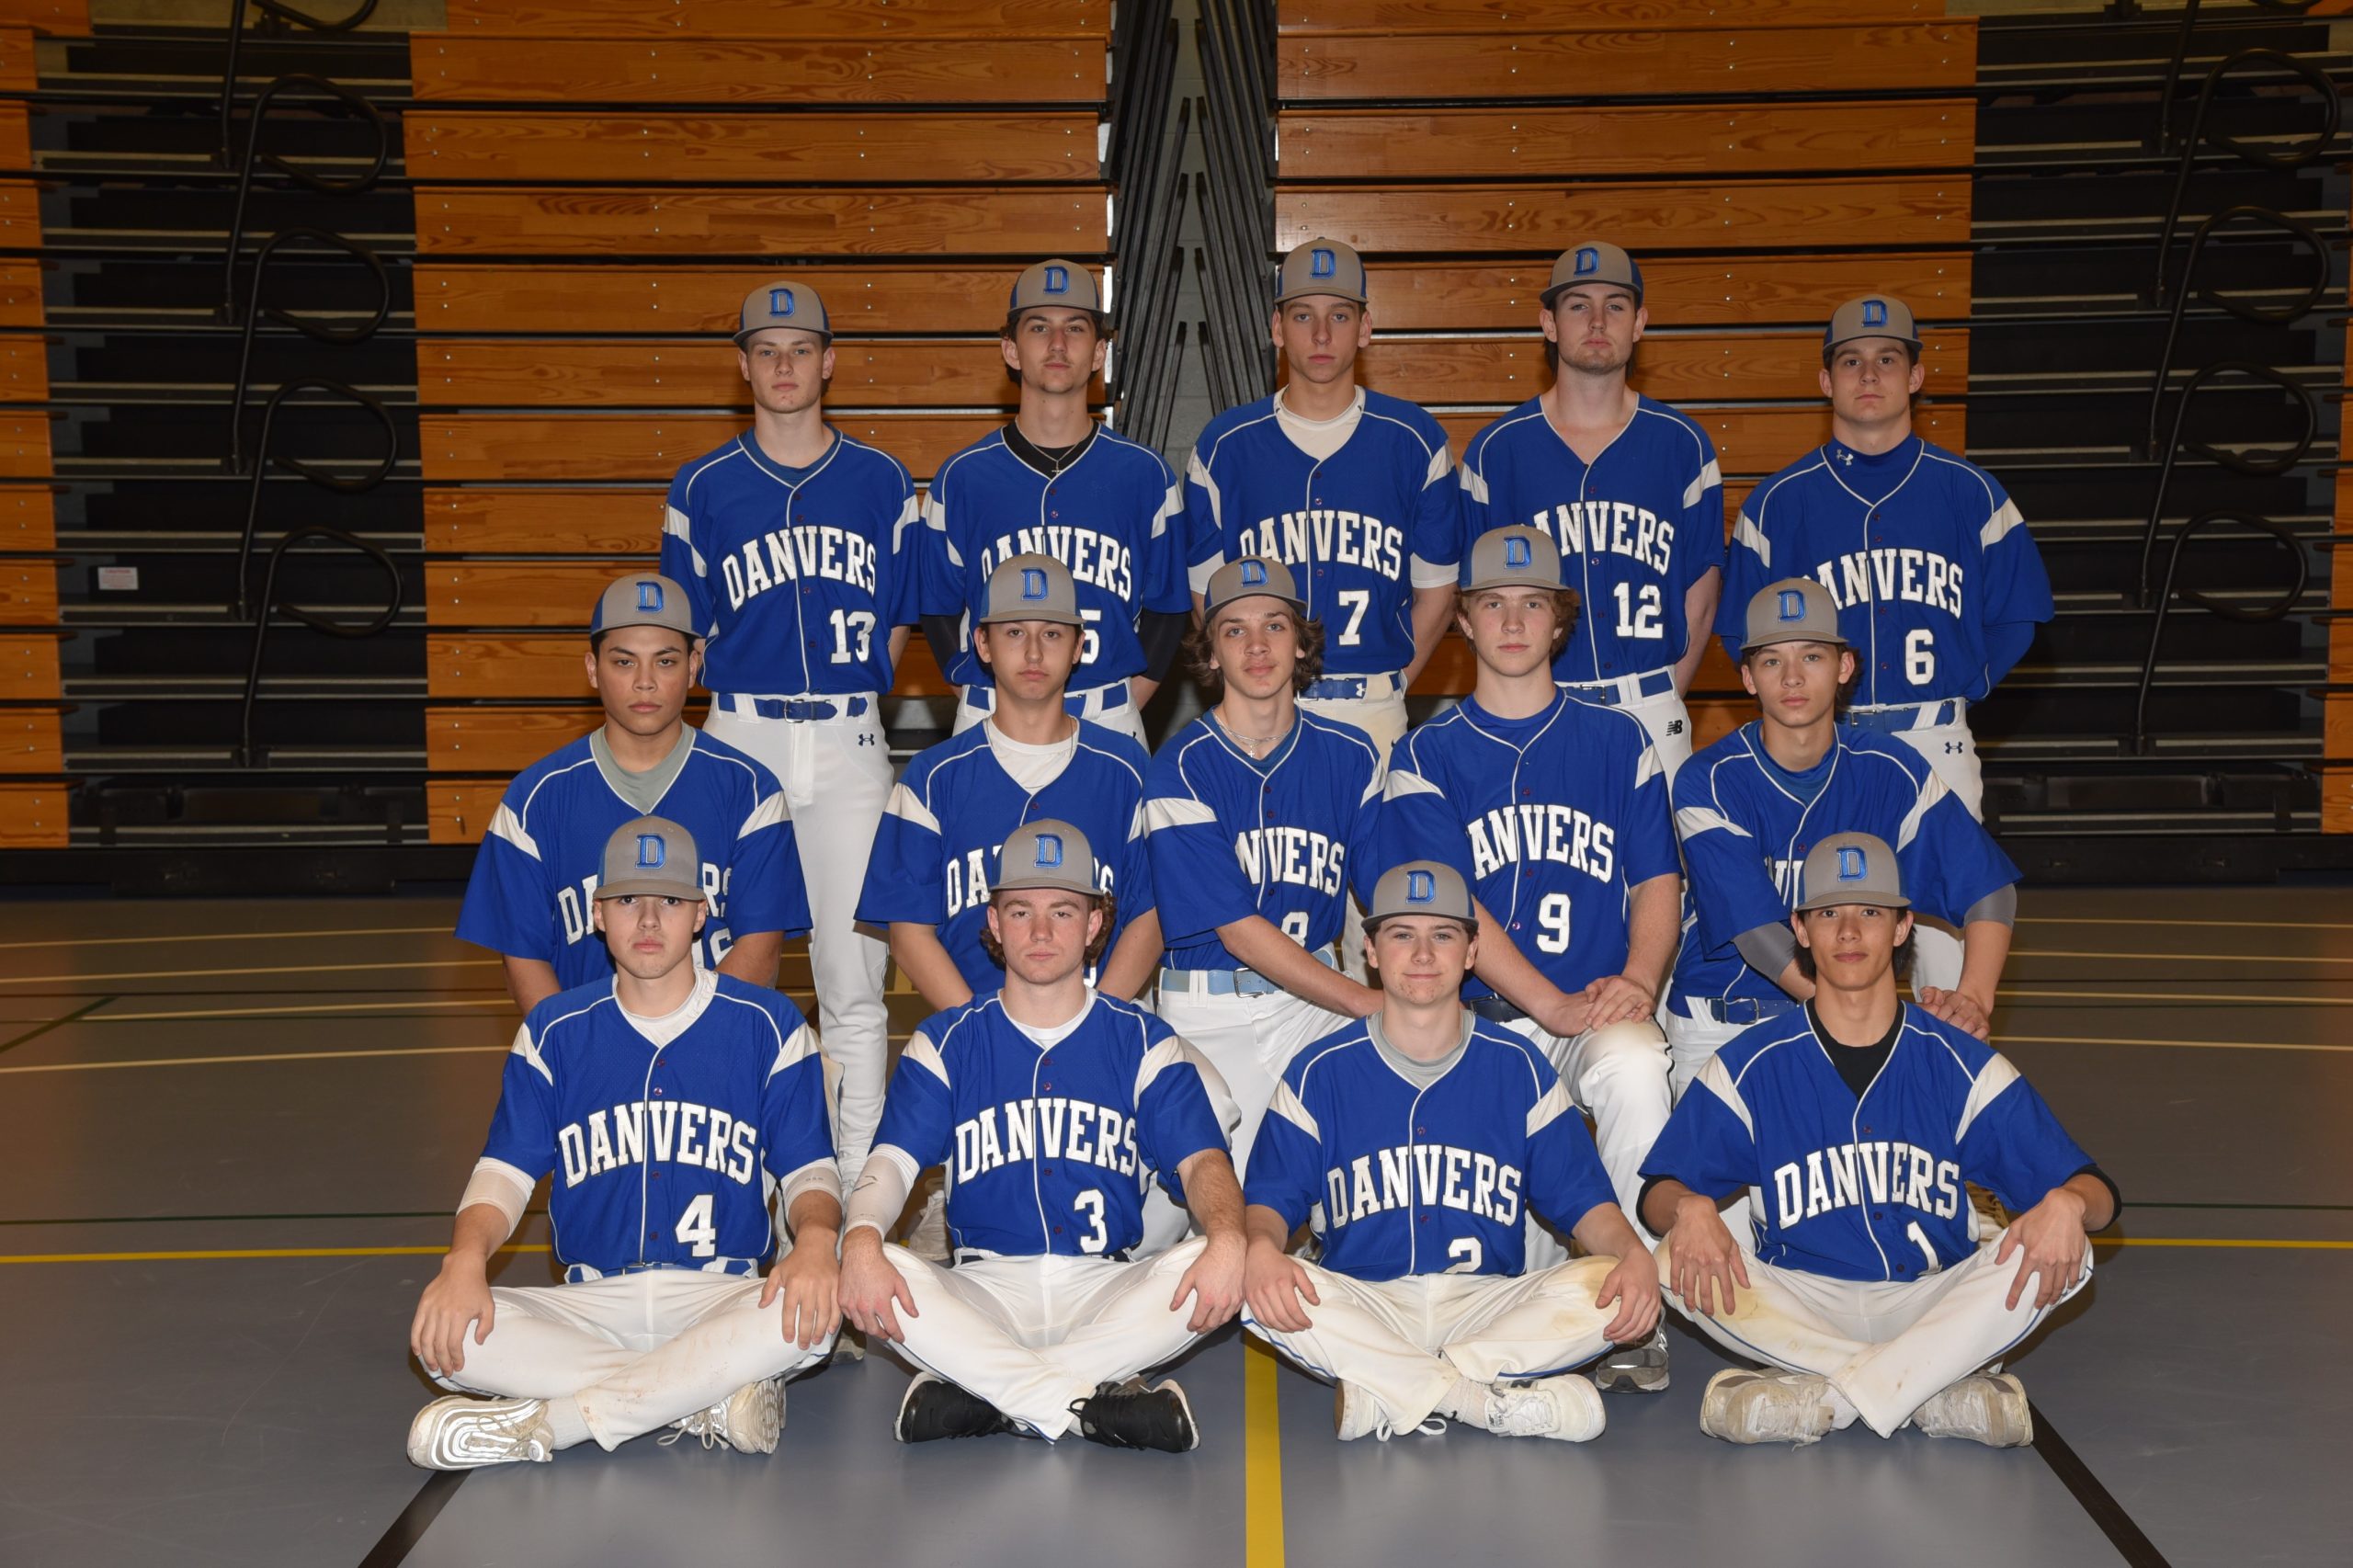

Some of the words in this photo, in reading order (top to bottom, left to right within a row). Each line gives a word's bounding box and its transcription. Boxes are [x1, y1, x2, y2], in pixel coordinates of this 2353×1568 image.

[1043, 266, 1070, 295] D
[1310, 248, 1336, 279] D
[1574, 247, 1600, 278] D
[768, 288, 796, 318] D
[1861, 300, 1888, 328] D
[1504, 536, 1533, 571] D
[1533, 500, 1675, 576] NVERS
[722, 525, 877, 612] DANVERS
[1020, 567, 1050, 602] D
[1239, 559, 1269, 588] D
[1802, 548, 1963, 619] ANVERS
[635, 581, 665, 614] D
[1338, 589, 1370, 646] 7
[1613, 582, 1664, 639] 12
[1778, 589, 1808, 624] D
[829, 608, 876, 665] 13
[1904, 629, 1935, 686] 6
[634, 834, 667, 870] D
[1033, 833, 1064, 869] D
[1234, 826, 1346, 897] NVERS
[1466, 803, 1615, 884] ANVERS
[1836, 845, 1870, 882] D
[1405, 869, 1436, 905] D
[1536, 892, 1572, 954] 9
[558, 1100, 757, 1188] DANVERS
[955, 1097, 1139, 1186] DANVERS
[1327, 1144, 1523, 1229] DANVERS
[1774, 1142, 1961, 1230] DANVERS
[675, 1194, 717, 1258] 4
[1074, 1188, 1108, 1254] 3
[1907, 1221, 1943, 1276] 1
[1442, 1237, 1482, 1275] 2
